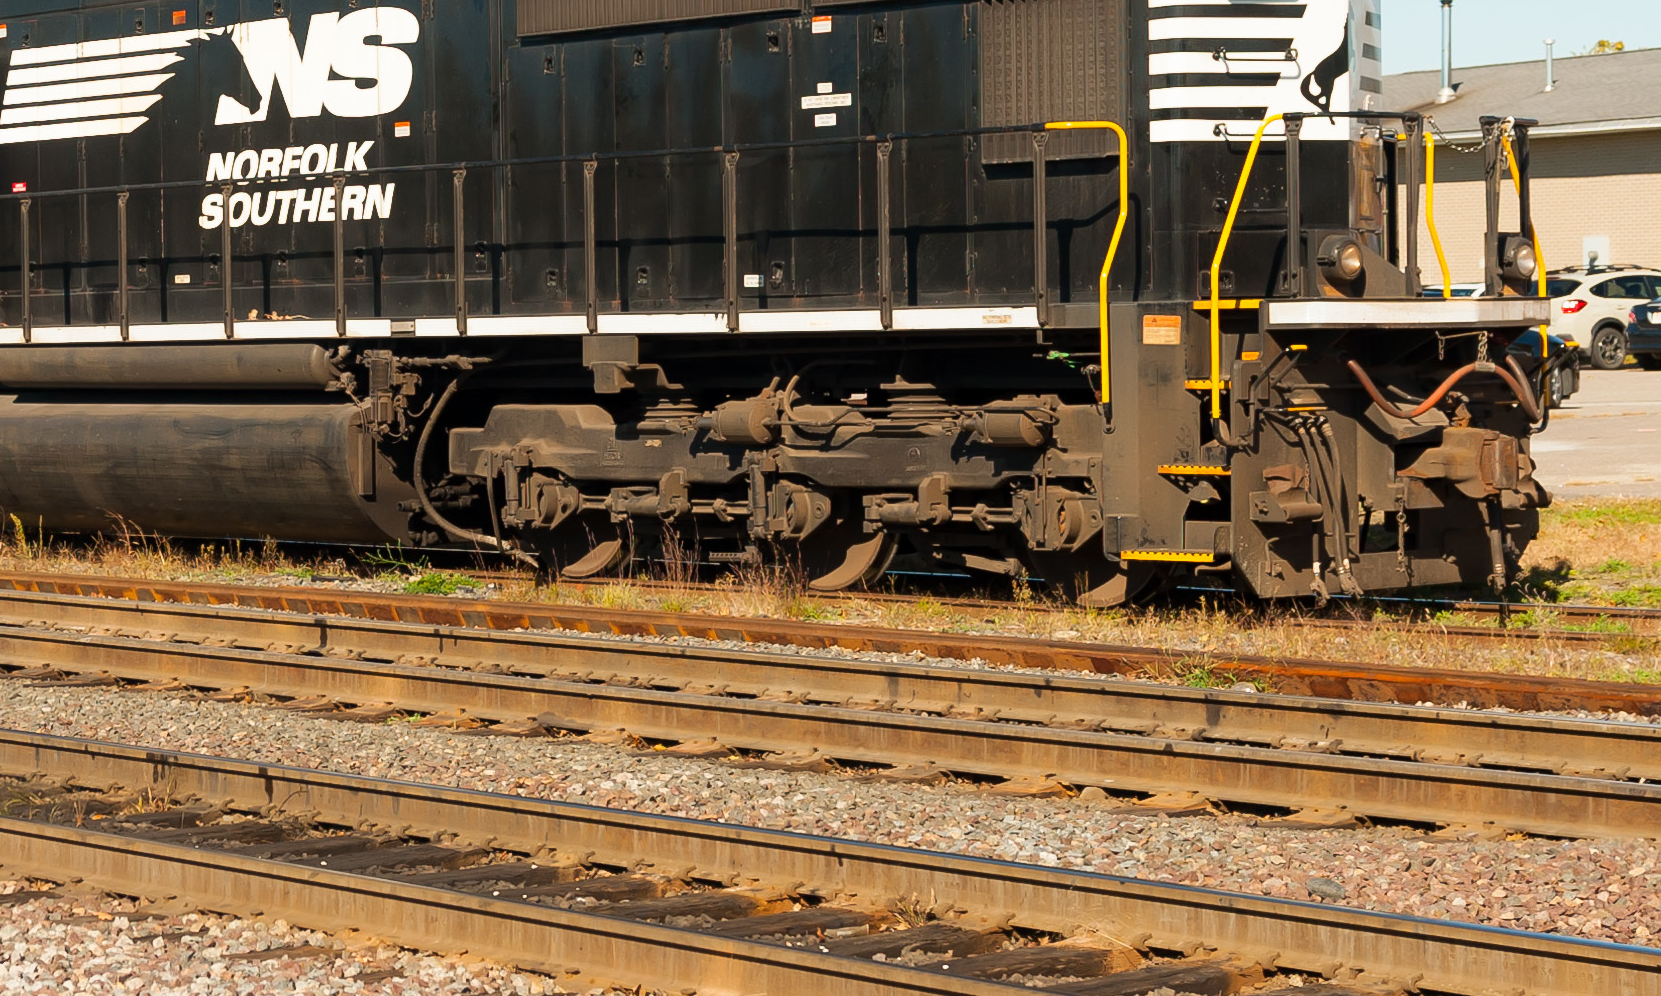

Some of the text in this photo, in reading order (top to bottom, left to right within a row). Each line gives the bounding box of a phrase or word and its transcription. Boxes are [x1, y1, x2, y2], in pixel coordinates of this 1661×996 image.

[214, 6, 421, 126] NS
[205, 140, 375, 186] NORFOLK
[198, 182, 396, 230] SOUTHERN
